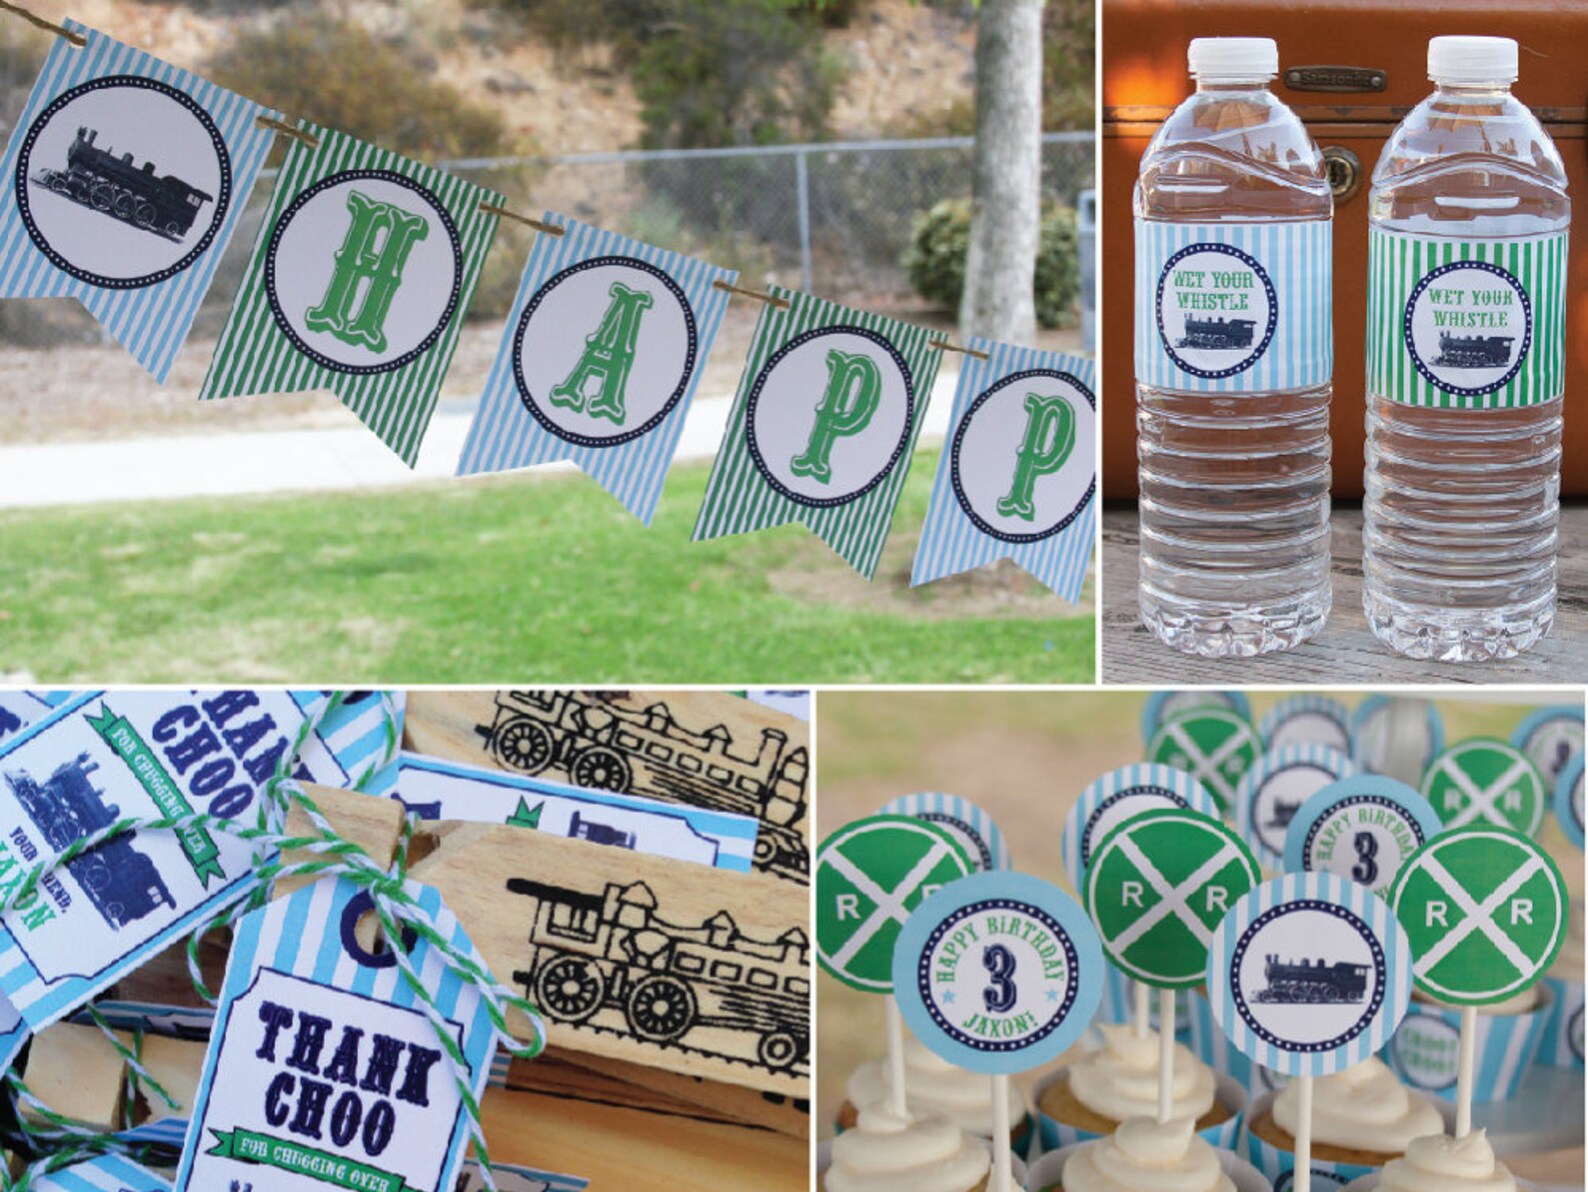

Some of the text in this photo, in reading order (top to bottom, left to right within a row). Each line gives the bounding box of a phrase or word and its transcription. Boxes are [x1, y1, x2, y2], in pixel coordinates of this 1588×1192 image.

[1173, 270, 1254, 288] WET YOUR
[1176, 292, 1249, 310] WHISTLE
[1429, 287, 1513, 305] WET YOUR
[1433, 310, 1508, 327] WHISTLE
[305, 190, 1076, 521] H A P P
[111, 727, 136, 757] FOR
[134, 754, 184, 818] CHUGGING
[152, 705, 254, 819] CHOO
[9, 826, 38, 862] YOUR
[1317, 807, 1415, 862] HAPPY BIRTHDA
[1352, 831, 1379, 887] 3
[836, 894, 860, 921] R
[1122, 881, 1228, 912] R R
[1425, 899, 1533, 927] R R
[936, 915, 1065, 983] HAPPY BIRTHDAY
[982, 943, 1018, 1014] 3
[962, 1010, 1040, 1039] JAXON!
[256, 1001, 441, 1107] THANK
[265, 1072, 397, 1157] CHOO
[238, 1137, 268, 1157] FOR
[272, 1146, 346, 1182] CHUGGING
